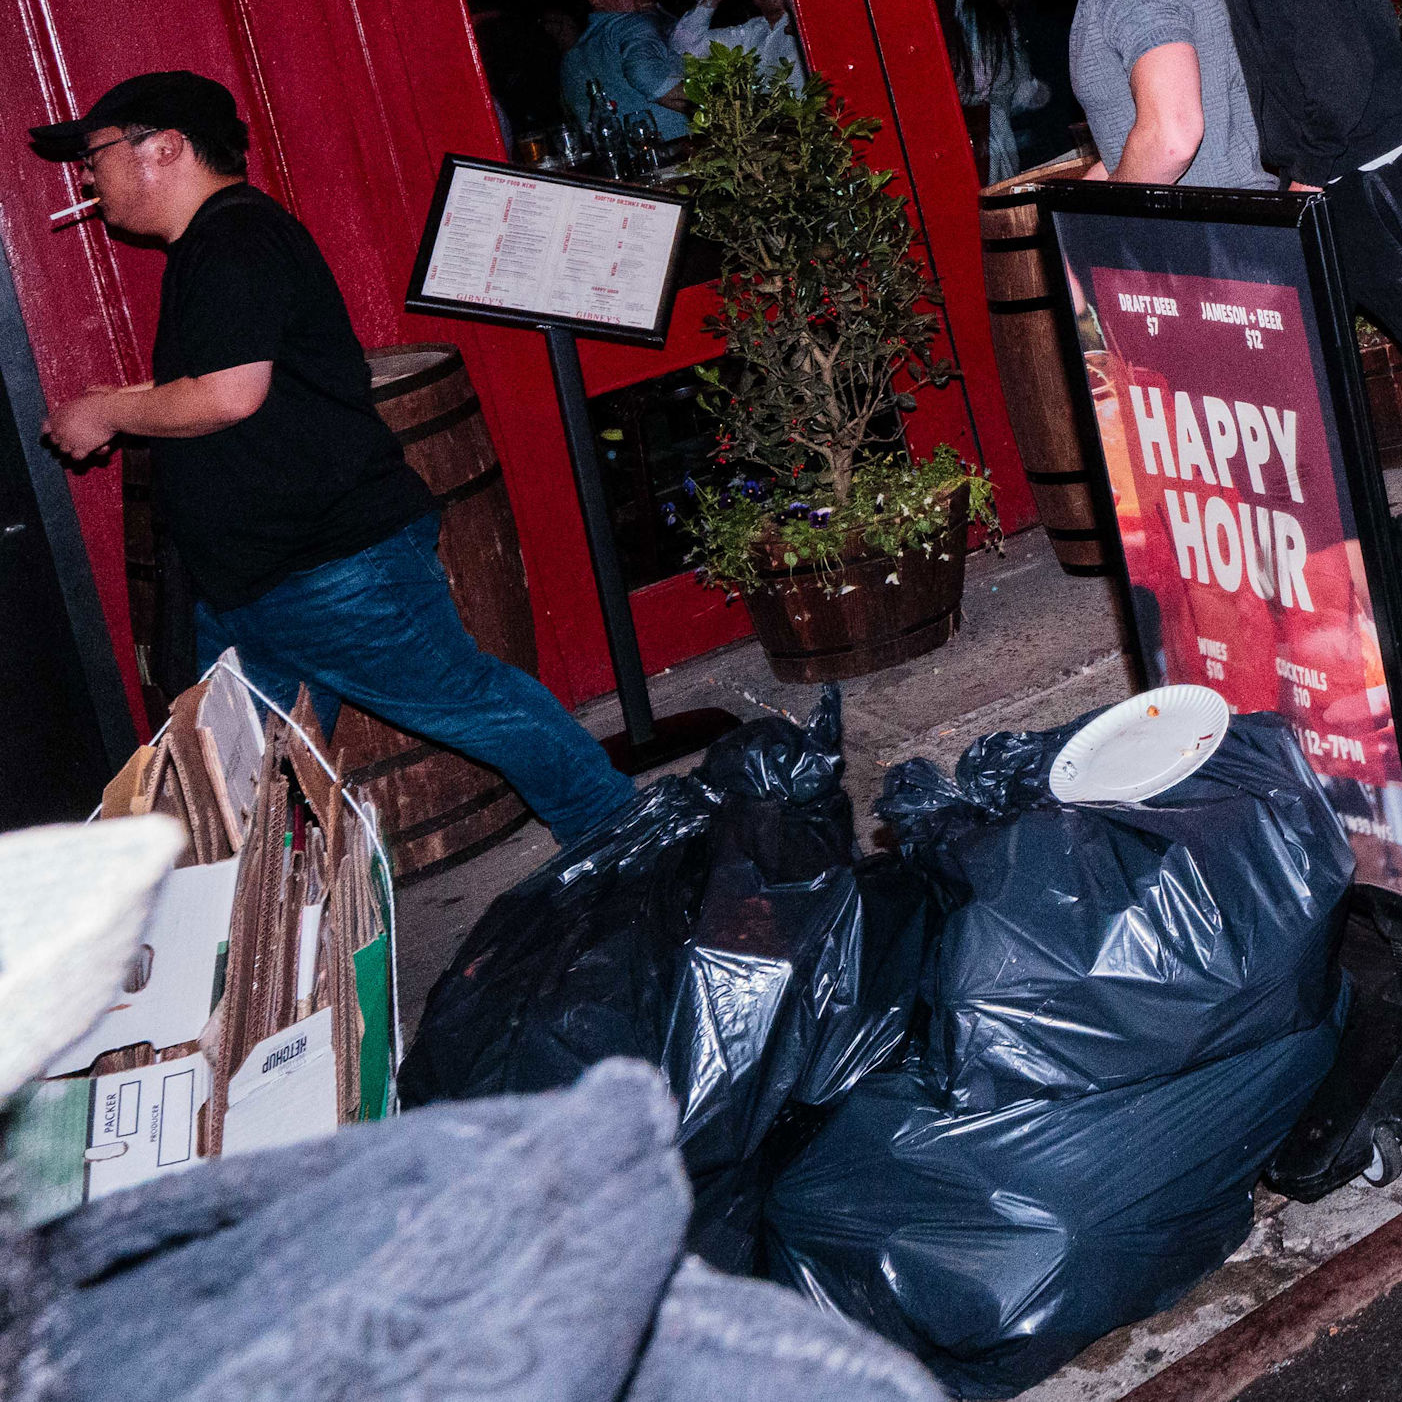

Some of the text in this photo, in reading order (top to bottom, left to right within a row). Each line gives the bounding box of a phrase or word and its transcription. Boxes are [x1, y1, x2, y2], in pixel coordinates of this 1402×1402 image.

[1118, 293, 1179, 316] DRAFT BEER
[1200, 301, 1284, 330] JAMESON + BEER
[1146, 315, 1158, 336] $7
[1245, 328, 1264, 349] $12
[1128, 385, 1305, 503] HAPPY
[1164, 489, 1315, 612] HOUR
[1197, 636, 1228, 662] WINES
[1206, 658, 1224, 681] $10
[1275, 657, 1327, 692] COCKTAILS
[1293, 684, 1311, 708] $10
[262, 1036, 307, 1074] KETCHUP
[104, 1093, 117, 1134] PACKER
[150, 1104, 160, 1142] PRODUCER
